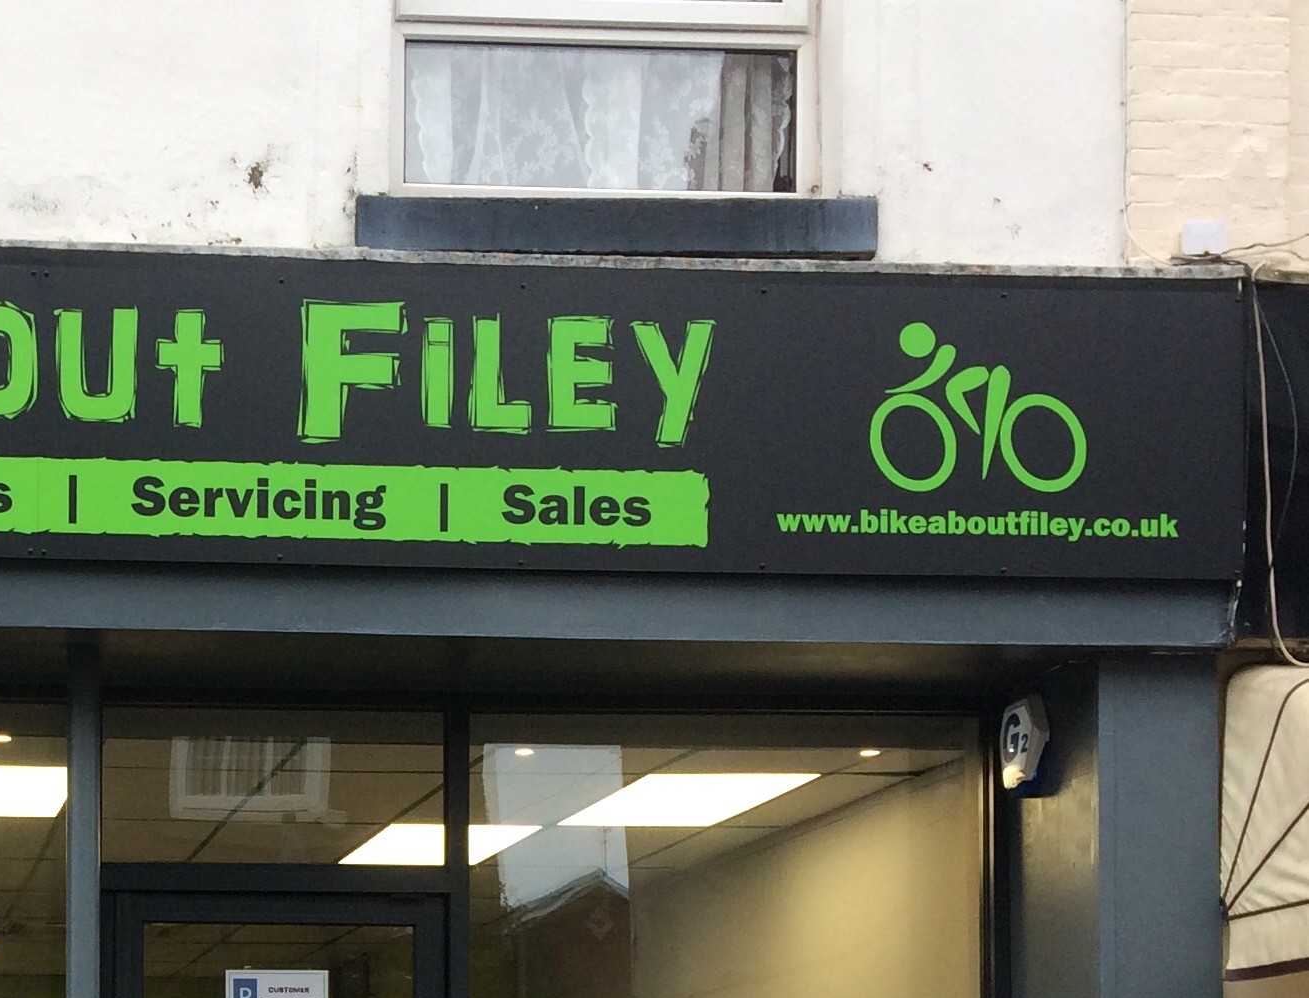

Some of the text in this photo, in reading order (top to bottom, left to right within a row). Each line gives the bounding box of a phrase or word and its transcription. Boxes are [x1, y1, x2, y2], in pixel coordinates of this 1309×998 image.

[132, 476, 387, 531] Servicing
[501, 485, 652, 526] Sales
[776, 508, 1179, 542] www.bikeaboutfiley.co.uk
[267, 986, 310, 994] CUSTOMER
